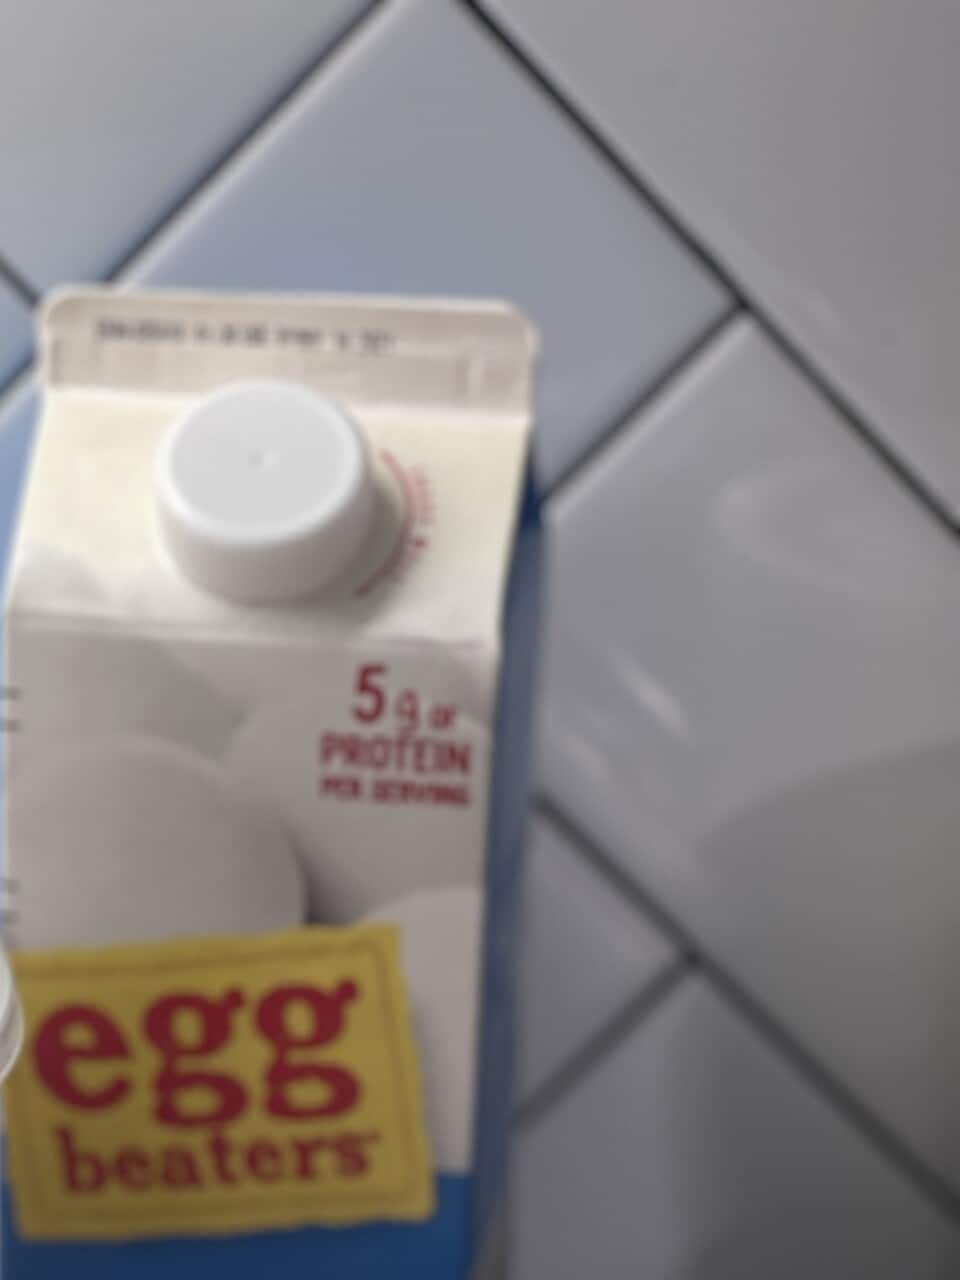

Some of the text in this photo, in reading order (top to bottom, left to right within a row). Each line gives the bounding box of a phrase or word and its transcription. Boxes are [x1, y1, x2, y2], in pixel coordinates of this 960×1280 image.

[319, 731, 470, 774] PROTEIN
[32, 979, 362, 1128] egg
[57, 1127, 372, 1196] beaters
